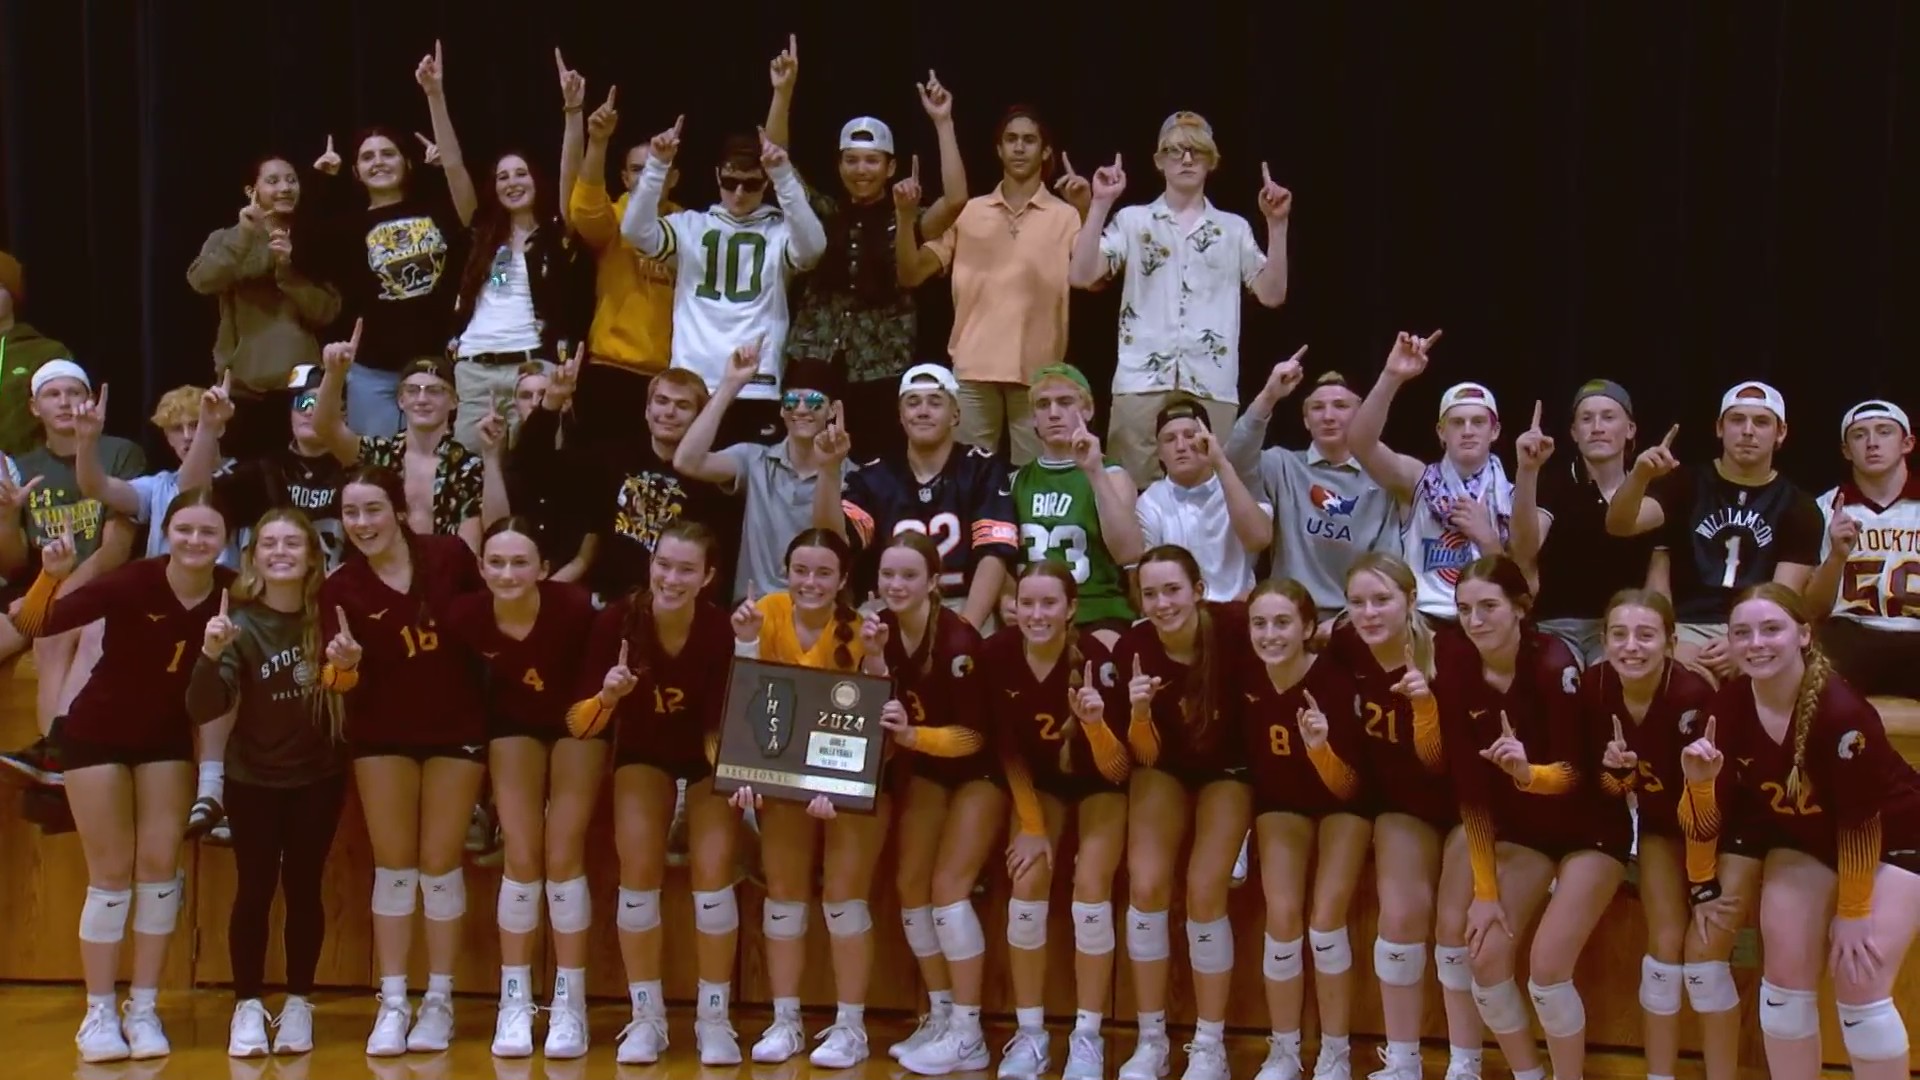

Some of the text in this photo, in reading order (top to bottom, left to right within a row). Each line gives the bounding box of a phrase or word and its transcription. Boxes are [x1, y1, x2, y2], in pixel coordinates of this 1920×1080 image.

[695, 229, 767, 303] 10
[287, 484, 336, 508] ROSBY
[1032, 491, 1072, 517] BIRD
[1306, 517, 1352, 542] USA
[1695, 507, 1773, 548] WILLIAMSON
[1856, 528, 1920, 554] TOCKT
[893, 512, 965, 585] 2
[1020, 523, 1091, 584] 33
[1722, 535, 1741, 588] 1
[400, 618, 438, 658] 16
[167, 640, 187, 673] 1
[522, 667, 545, 692] 4
[653, 685, 686, 714] 12
[766, 683, 781, 750] IHSA
[817, 711, 866, 733] 2024
[1366, 702, 1398, 743] 21
[1269, 724, 1291, 756] 8
